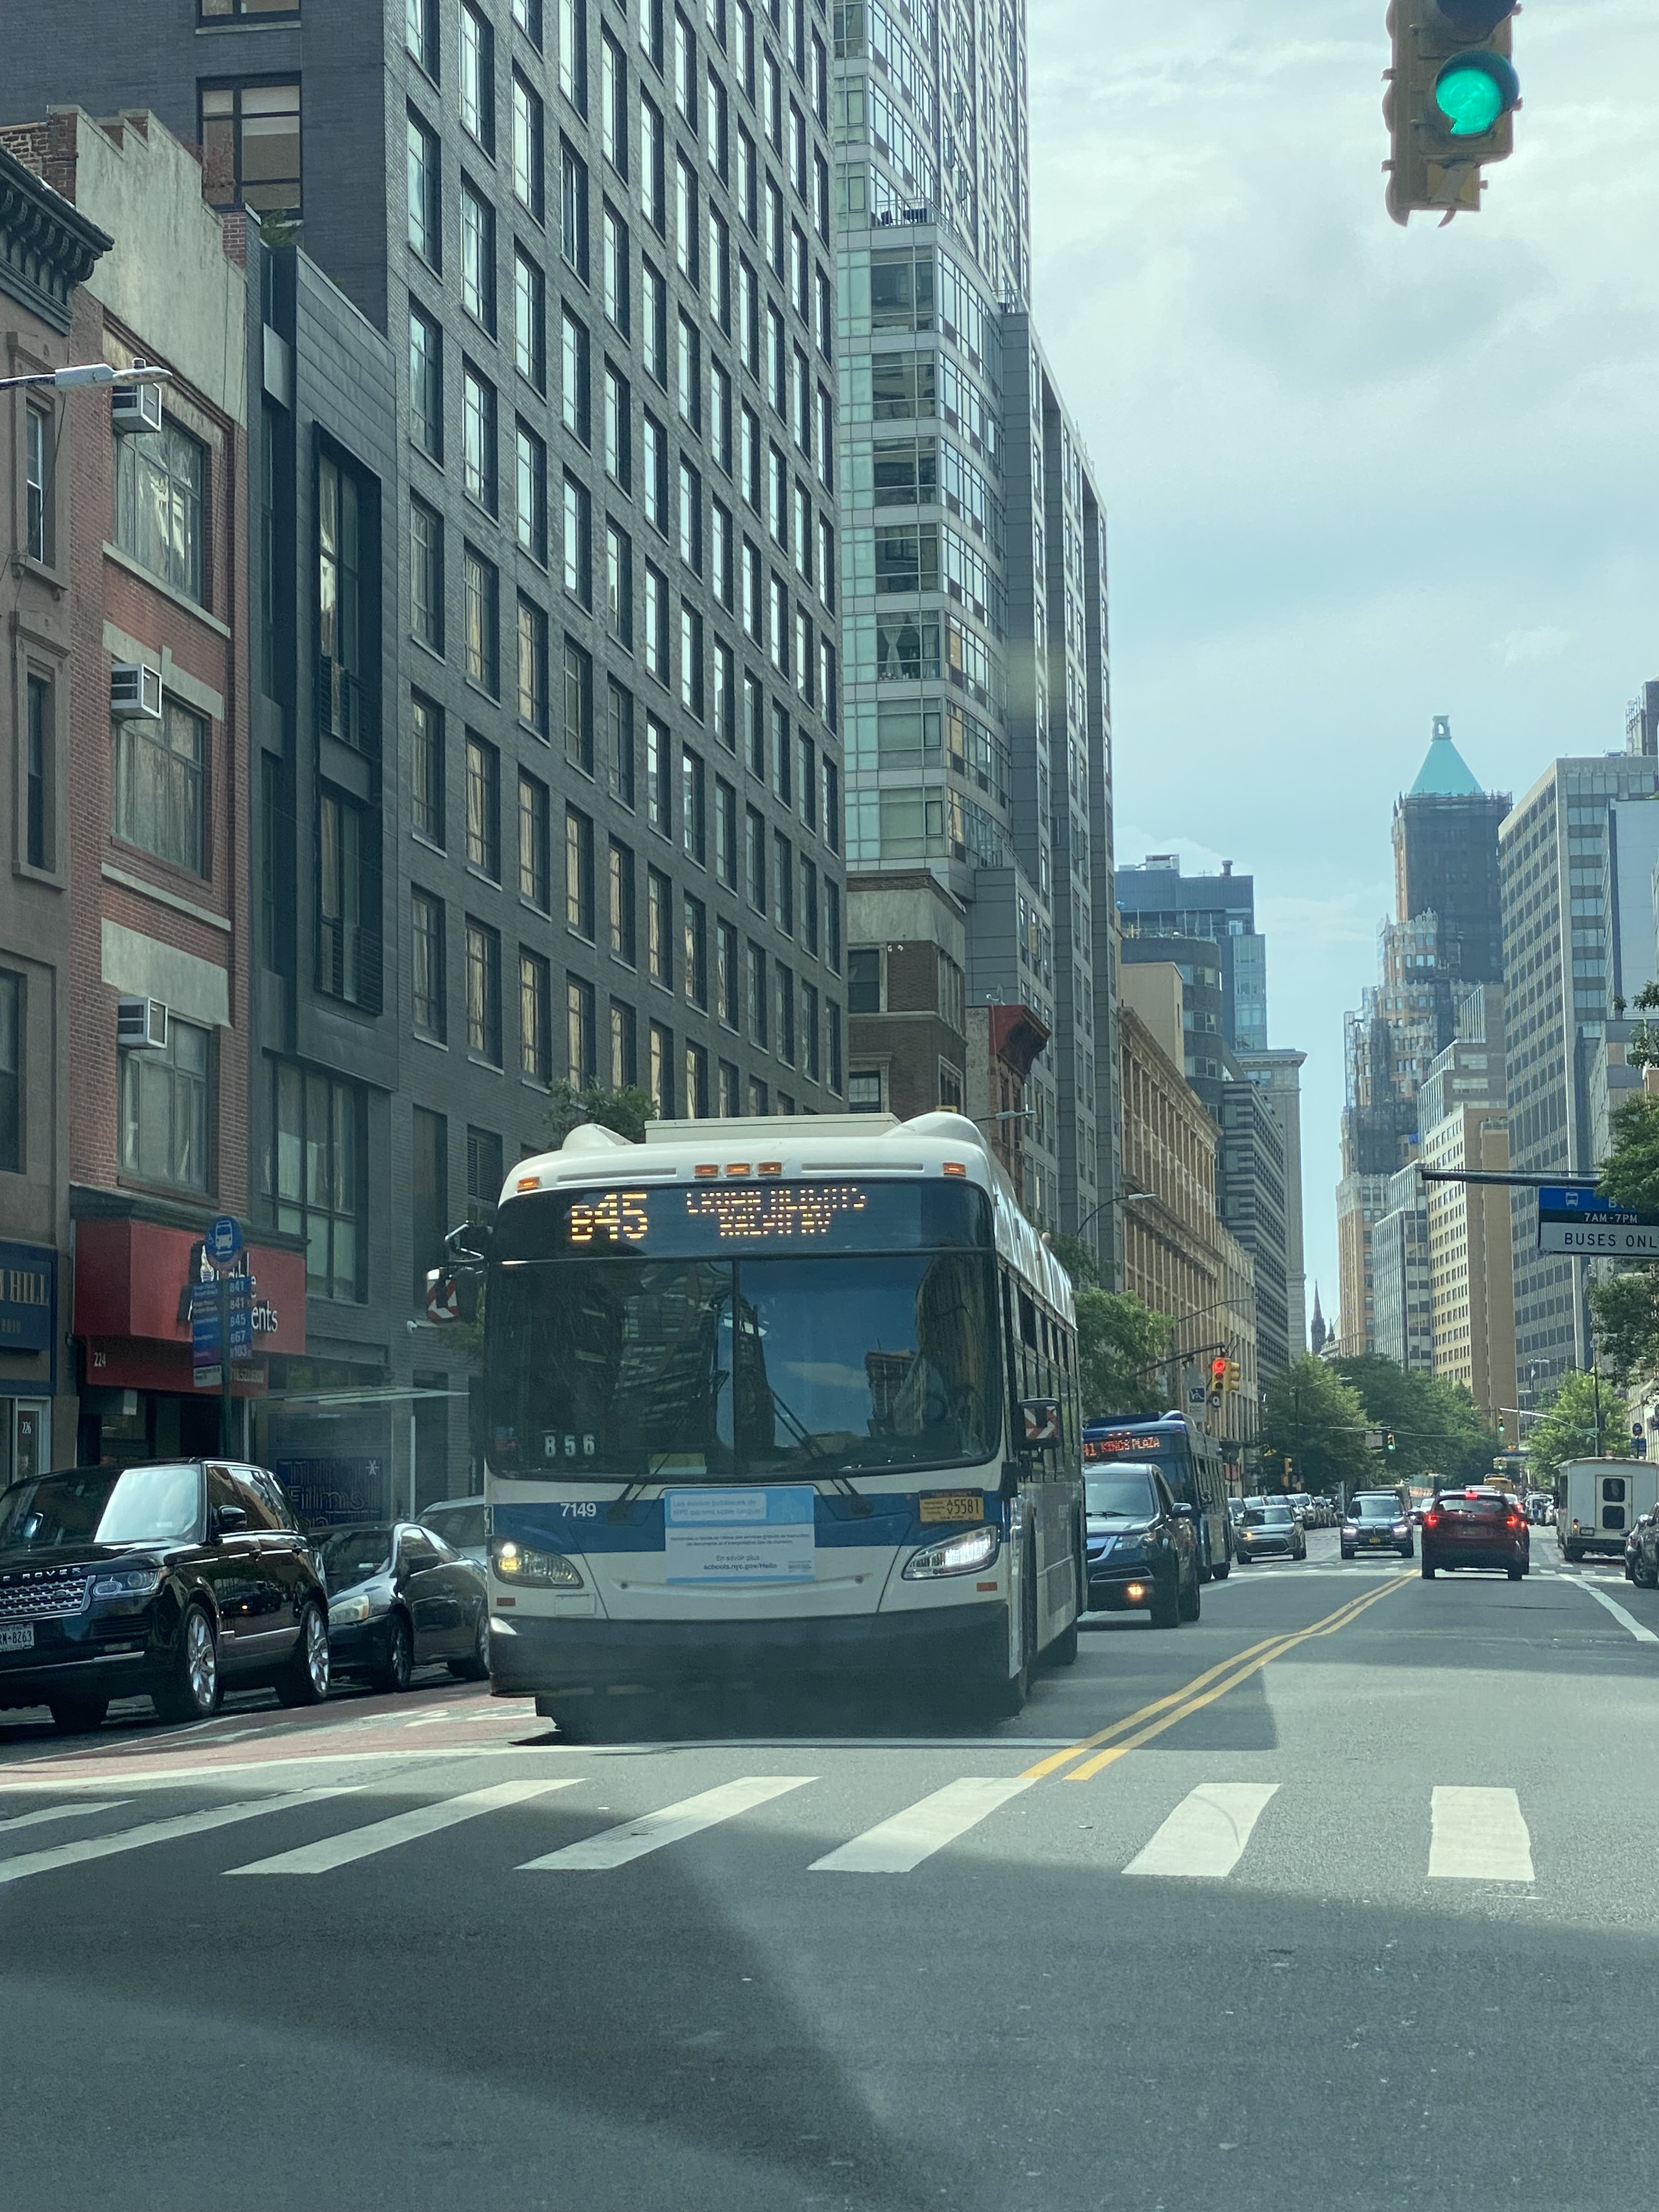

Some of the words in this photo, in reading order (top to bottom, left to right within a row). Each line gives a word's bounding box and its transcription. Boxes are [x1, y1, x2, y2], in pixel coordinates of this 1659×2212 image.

[571, 1193, 648, 1240] B45
[1565, 1233, 1616, 1246] BUSES
[1626, 1235, 1659, 1248] ONL
[10, 1269, 50, 1306] HILL
[230, 1280, 245, 1292] B41
[230, 1297, 245, 1310] B41
[230, 1314, 246, 1327] B45
[230, 1330, 246, 1343] B67
[94, 1351, 106, 1367] 224
[22, 1421, 32, 1434] 226
[560, 1502, 597, 1517] 7149
[22, 1567, 81, 1579] ROVER
